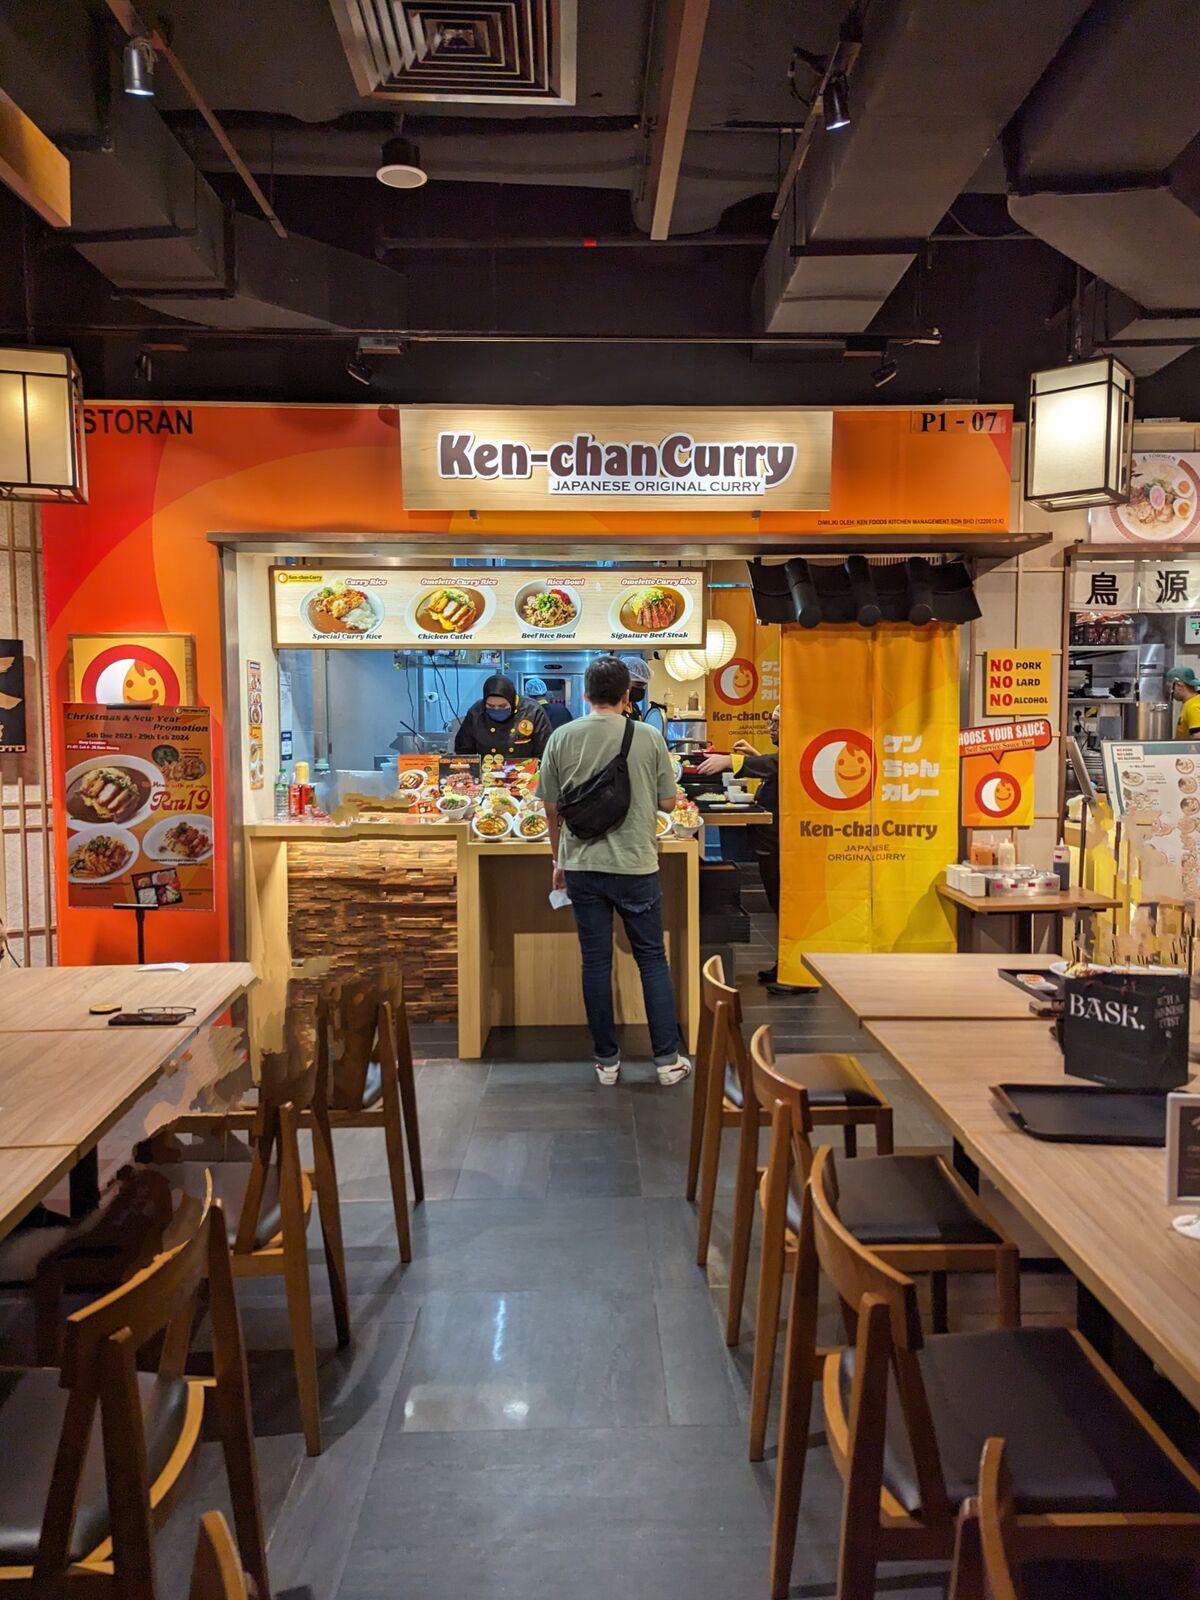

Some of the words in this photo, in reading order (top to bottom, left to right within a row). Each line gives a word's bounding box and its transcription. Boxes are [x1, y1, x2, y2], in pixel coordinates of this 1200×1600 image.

[920, 412, 946, 432] P1
[972, 411, 998, 432] 07
[553, 480, 631, 491] JAPANESE
[635, 480, 706, 491] ORIGINAL
[709, 481, 761, 492] CURRY
[345, 579, 368, 587] Curry
[369, 578, 387, 586] Rice
[456, 579, 480, 587] Curry
[546, 578, 563, 586] Rice
[564, 578, 585, 586] Bowl
[656, 578, 680, 586] Curry
[611, 632, 648, 640] Signature
[667, 631, 688, 639] Steak
[990, 659, 1013, 672] NO
[1015, 662, 1042, 670] PORK
[990, 676, 1013, 688] NO
[1016, 678, 1040, 687] LARD
[990, 694, 1013, 706] NO
[67, 712, 121, 721] Christmas
[158, 715, 181, 723] Year
[713, 711, 760, 721] Ken-chan
[153, 723, 208, 732] Promotion
[988, 726, 1014, 742] YOUR
[1015, 722, 1046, 739] SAUCE
[883, 734, 922, 753] ケン
[882, 759, 940, 778] ちゃん
[881, 783, 940, 802] カレー
[150, 789, 211, 812] Rm19
[882, 820, 938, 841] Curry
[876, 853, 906, 861] CURRY
